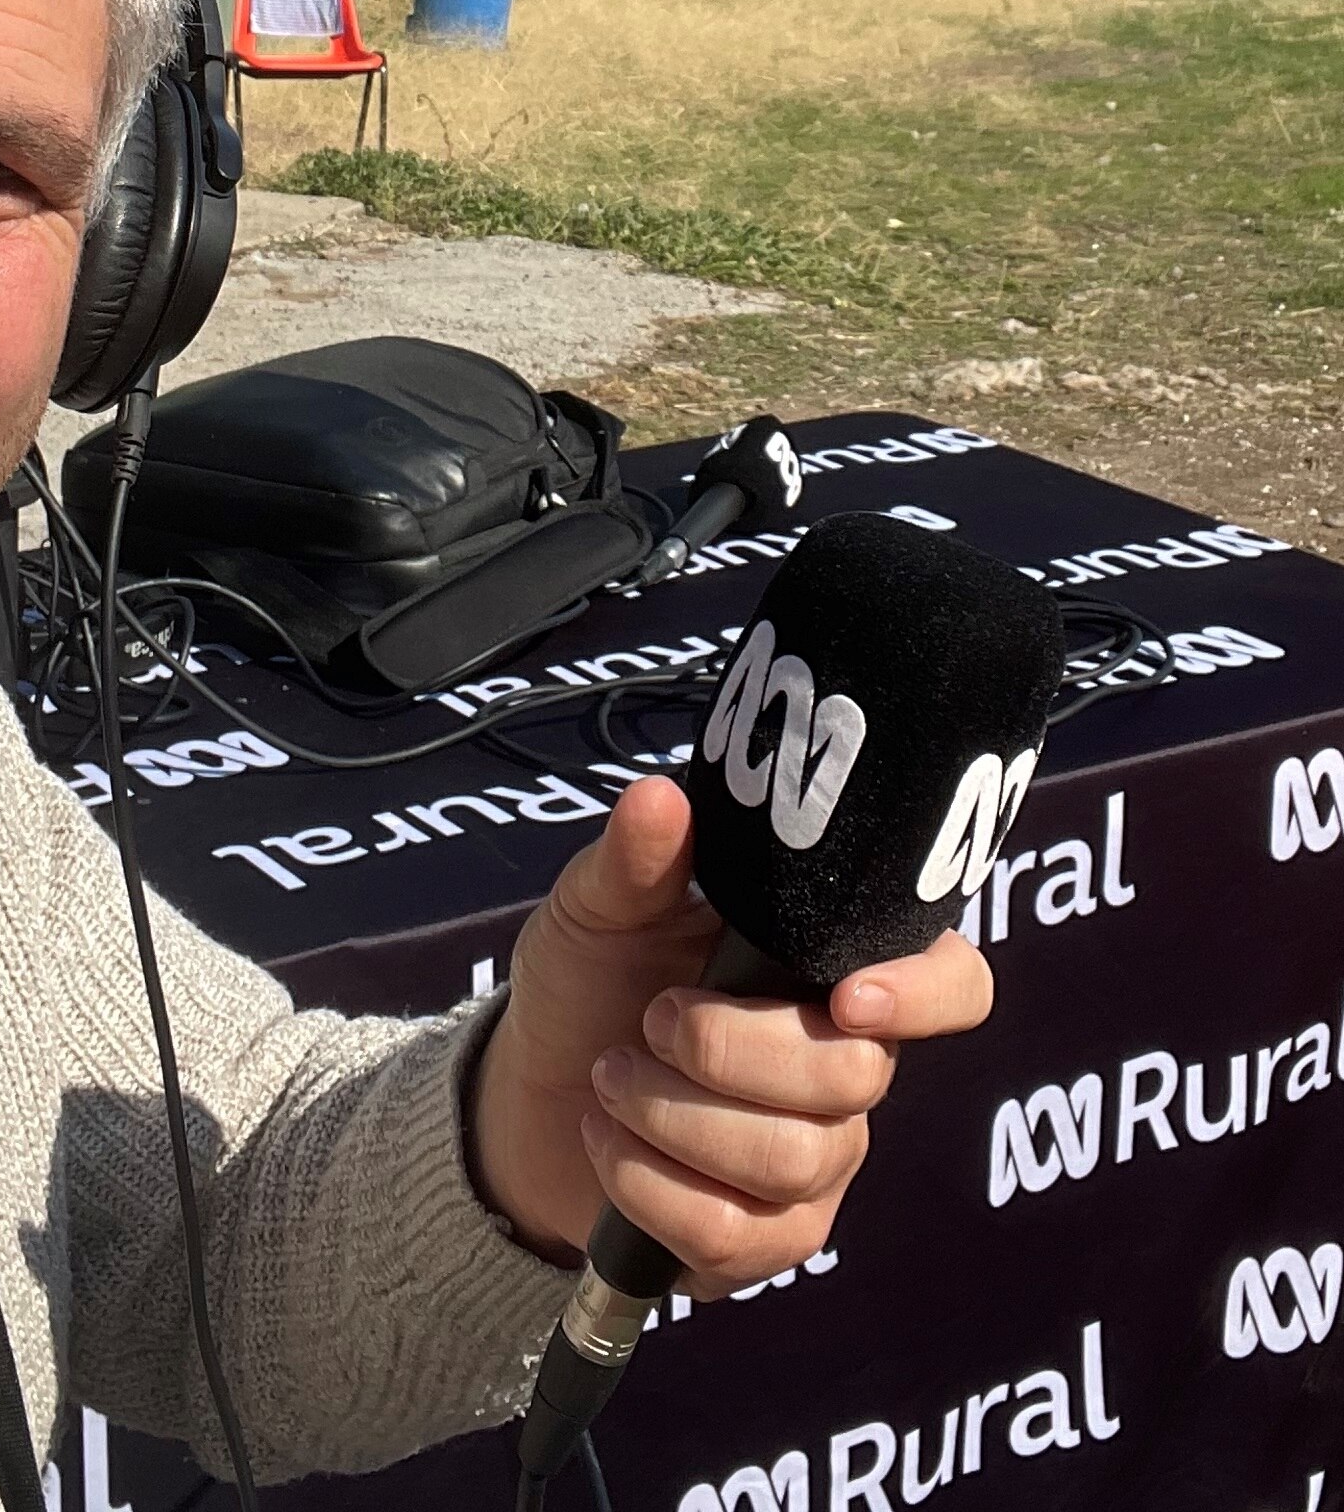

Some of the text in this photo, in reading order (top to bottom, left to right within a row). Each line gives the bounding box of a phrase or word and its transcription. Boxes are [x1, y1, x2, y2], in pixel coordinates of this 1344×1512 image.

[212, 774, 612, 892] Rural
[958, 791, 1136, 948] ral
[829, 1320, 1121, 1512] Rural
